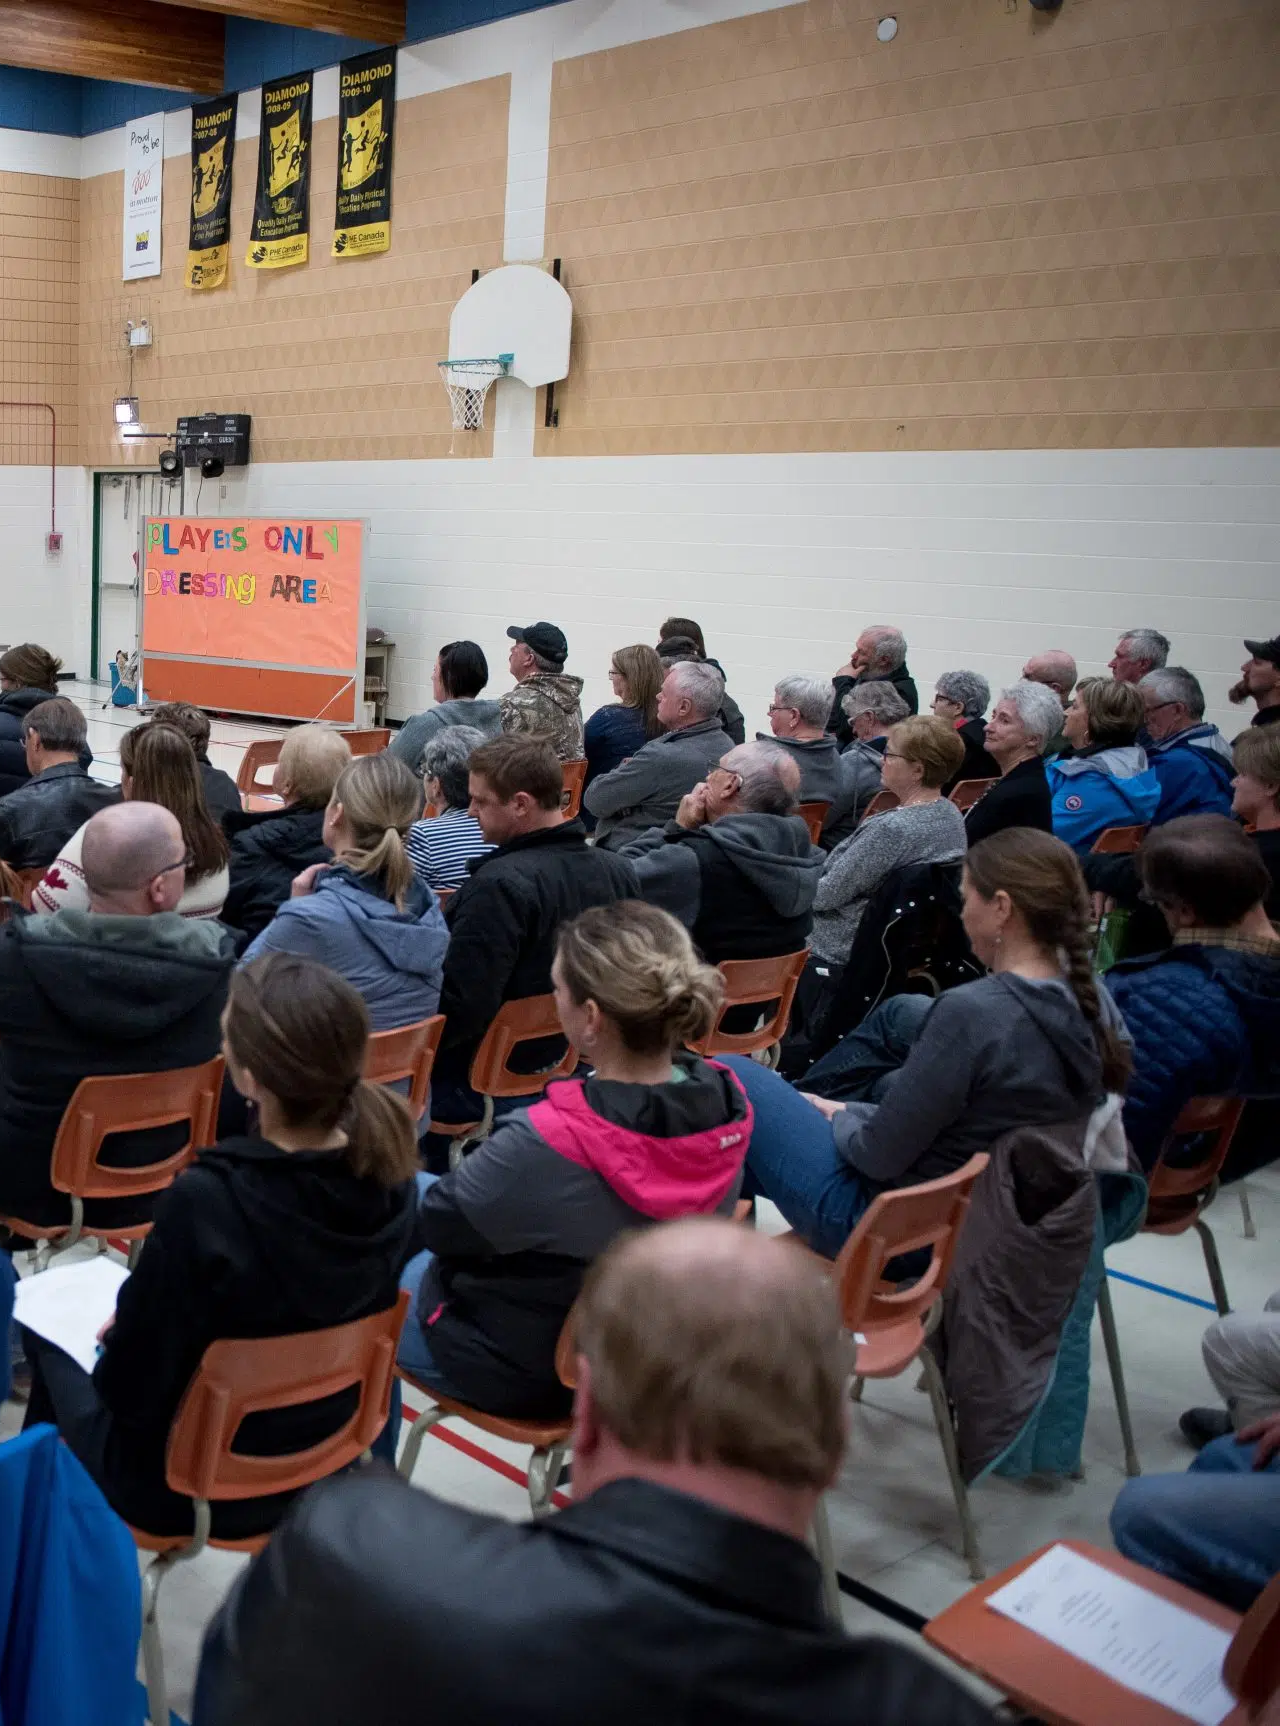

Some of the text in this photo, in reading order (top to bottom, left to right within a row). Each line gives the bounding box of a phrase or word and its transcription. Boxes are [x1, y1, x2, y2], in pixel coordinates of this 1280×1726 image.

[341, 63, 393, 88] DIAMOND
[265, 81, 310, 105] DIAMOND
[341, 84, 371, 98] 2009-10
[130, 128, 150, 146] Proud
[142, 136, 160, 156] to be
[358, 230, 385, 242] Canada
[281, 243, 304, 254] Canada
[264, 524, 339, 560] ONLY
[270, 574, 334, 604] AREA
